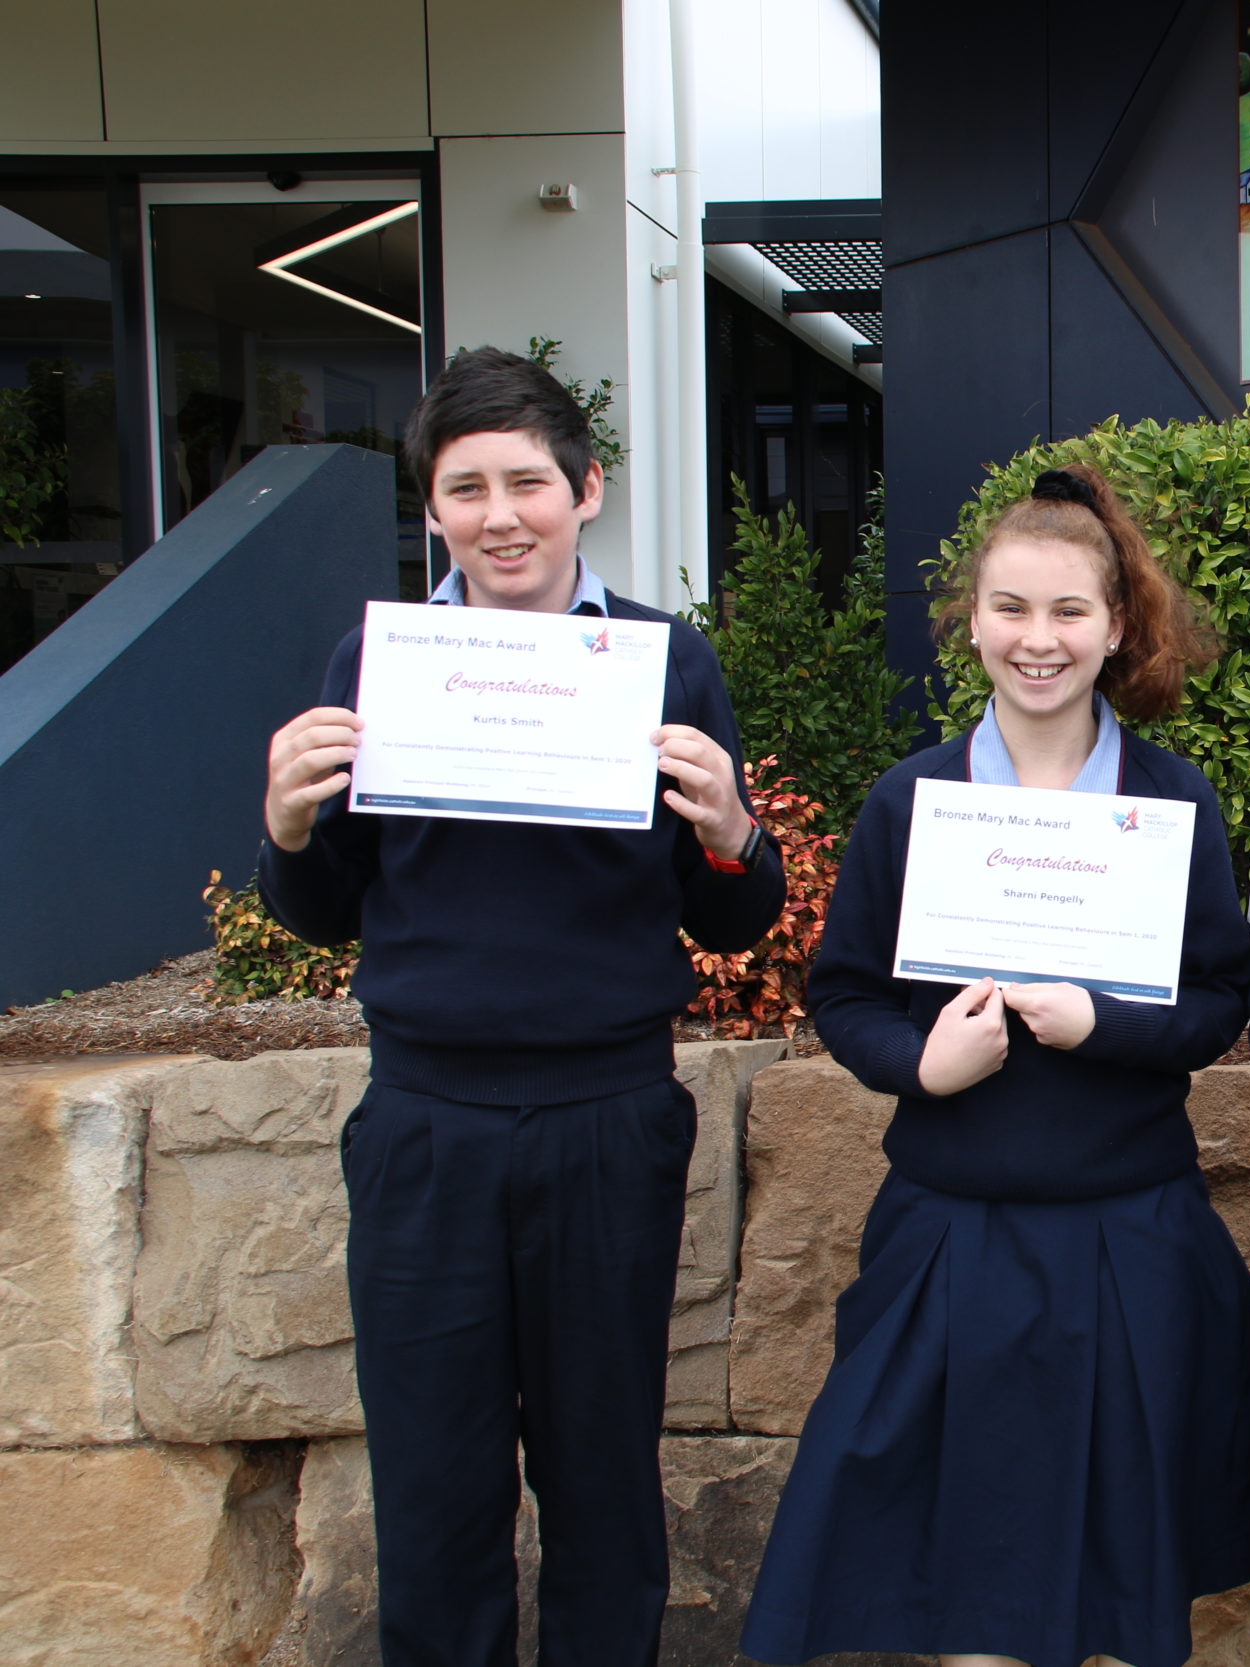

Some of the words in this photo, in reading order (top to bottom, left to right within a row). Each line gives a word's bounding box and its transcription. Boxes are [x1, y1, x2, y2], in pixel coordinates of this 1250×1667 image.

[386, 631, 430, 644] Bronze
[433, 634, 464, 648] Mary
[467, 636, 492, 648] Mac
[495, 639, 536, 652] Award
[444, 671, 577, 697] Congratulations
[472, 714, 507, 725] Kurtis
[510, 716, 543, 727] Smith
[933, 807, 974, 821] Bronze
[976, 811, 1004, 826] Mary
[1007, 814, 1030, 826] Mac
[1033, 817, 1070, 830] Award
[986, 847, 1107, 874] Congratulations
[1002, 888, 1037, 899] Sharni
[1039, 892, 1084, 905] Pengelly
